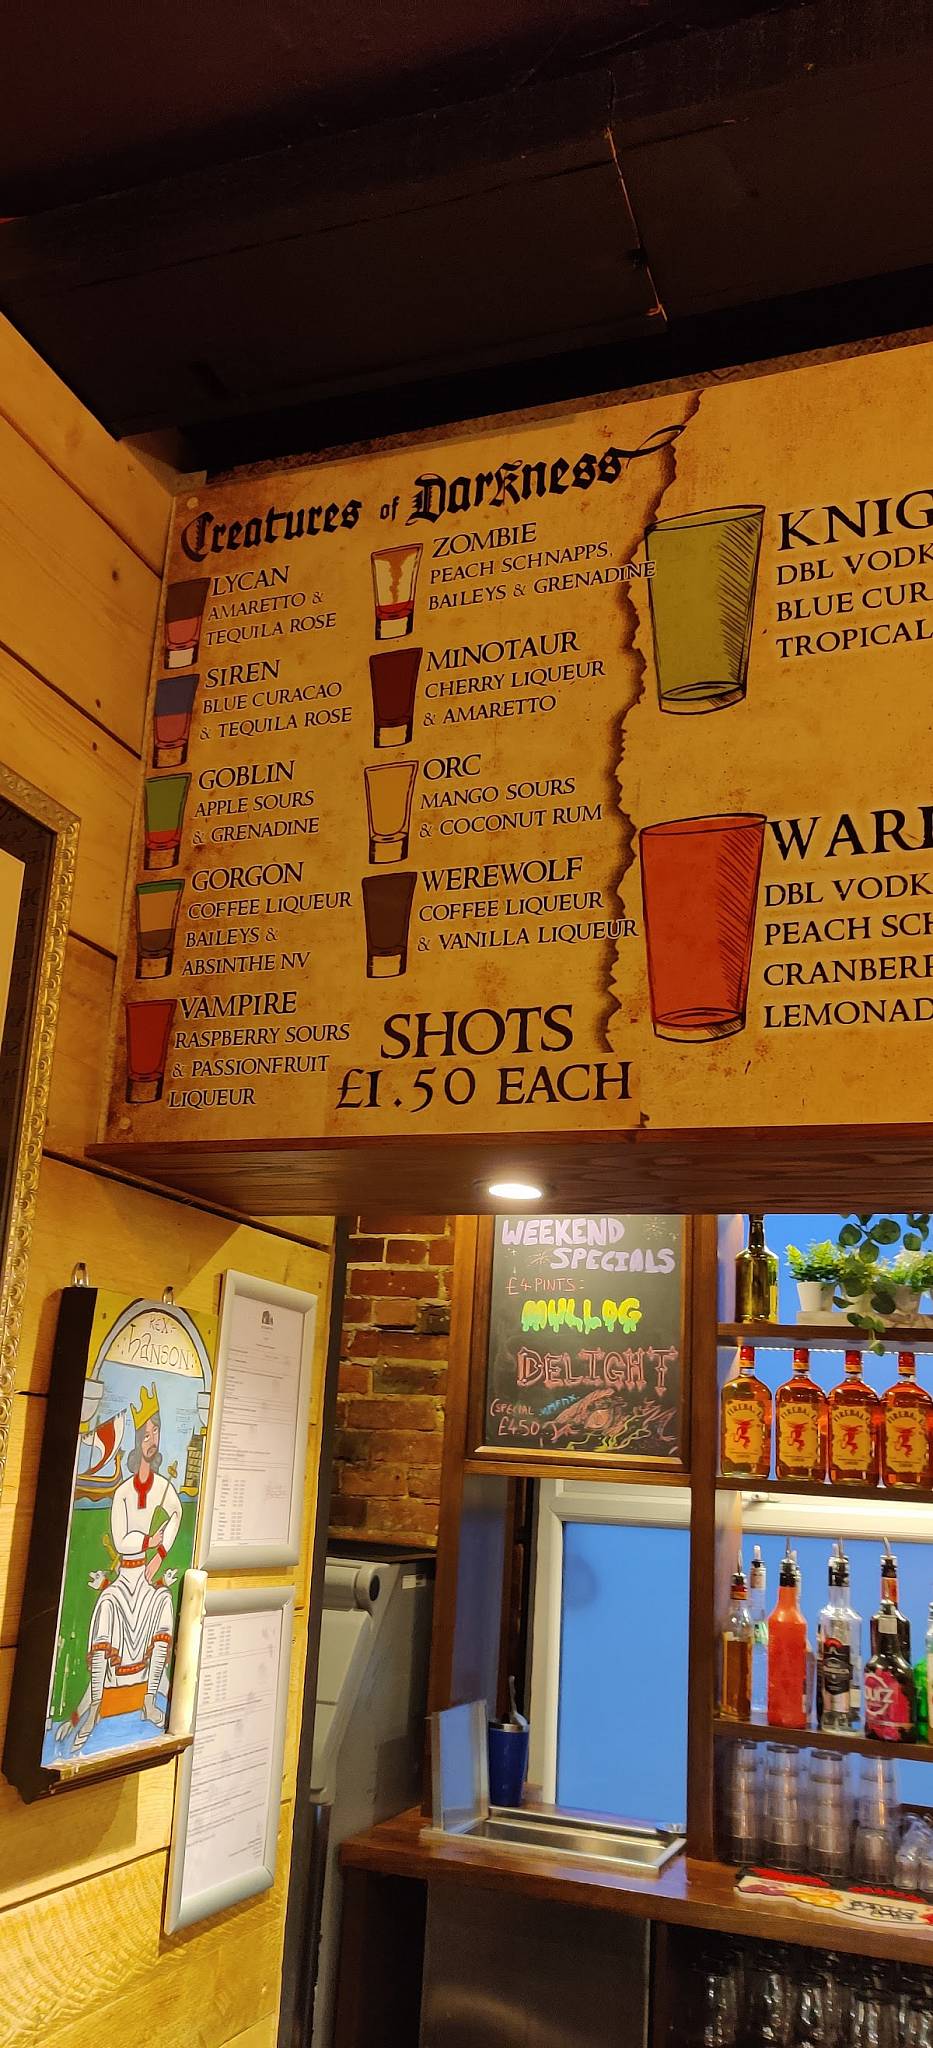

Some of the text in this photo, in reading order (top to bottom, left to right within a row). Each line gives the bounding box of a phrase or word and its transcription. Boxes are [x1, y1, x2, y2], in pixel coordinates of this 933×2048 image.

[181, 499, 362, 562] Creatures
[379, 496, 400, 520] of
[777, 489, 933, 551] KNIG
[431, 522, 537, 558] ZOMBIE
[430, 541, 613, 584] PEACH SCHNAPPS,
[776, 542, 933, 585] DBL VODK
[211, 565, 290, 596] LYCAN
[428, 561, 656, 611] BAILEYS & GRENADINE
[208, 592, 323, 621] AMARETTO &
[776, 592, 854, 621] BLUE
[207, 612, 336, 645] TEQUILA ROSE
[776, 619, 933, 658] TROPICAL
[426, 631, 580, 672] MINOTAUR
[205, 660, 280, 688] SIREN
[425, 660, 606, 698] CHERRY LIQUEUR
[203, 682, 342, 714] BLUE CURACAO
[423, 695, 556, 727] & AMARETTO
[200, 707, 352, 740] & TEQUILA ROSE
[199, 760, 295, 790] GOBLIN
[423, 754, 481, 780] ORC
[194, 790, 314, 817] APPLE SOURS
[420, 777, 575, 809] MANGO SOURS
[192, 818, 320, 845] & GRENADINE
[419, 804, 602, 838] & COCONUT RUM
[192, 862, 304, 890] GORGON
[421, 857, 583, 892] WEREWOLF
[765, 872, 933, 907] DBL VODK
[188, 892, 352, 919] COFFEE LIQUEUR
[419, 891, 604, 921] COFFEE LIQUEUR
[186, 927, 278, 947] BAILEYS &
[417, 919, 639, 951] & VANILLA LIQUEUR
[765, 916, 871, 945] PEACH
[182, 952, 311, 976] ABSINTHE NV
[179, 991, 297, 1019] VAMPIRE
[764, 997, 933, 1028] LEMONAD
[175, 1024, 350, 1048] RASPBERRY SOURS
[380, 1004, 573, 1059] SHOTS
[172, 1055, 330, 1077] & PASSIONFRUIT
[168, 1088, 256, 1109] LIQUEUR
[335, 1061, 634, 1113] £1.50 EACH
[502, 1217, 625, 1246] WEEKEND
[550, 1247, 676, 1274] SPECIALS
[506, 1277, 532, 1296] £4
[516, 1345, 679, 1397] DELIGHT
